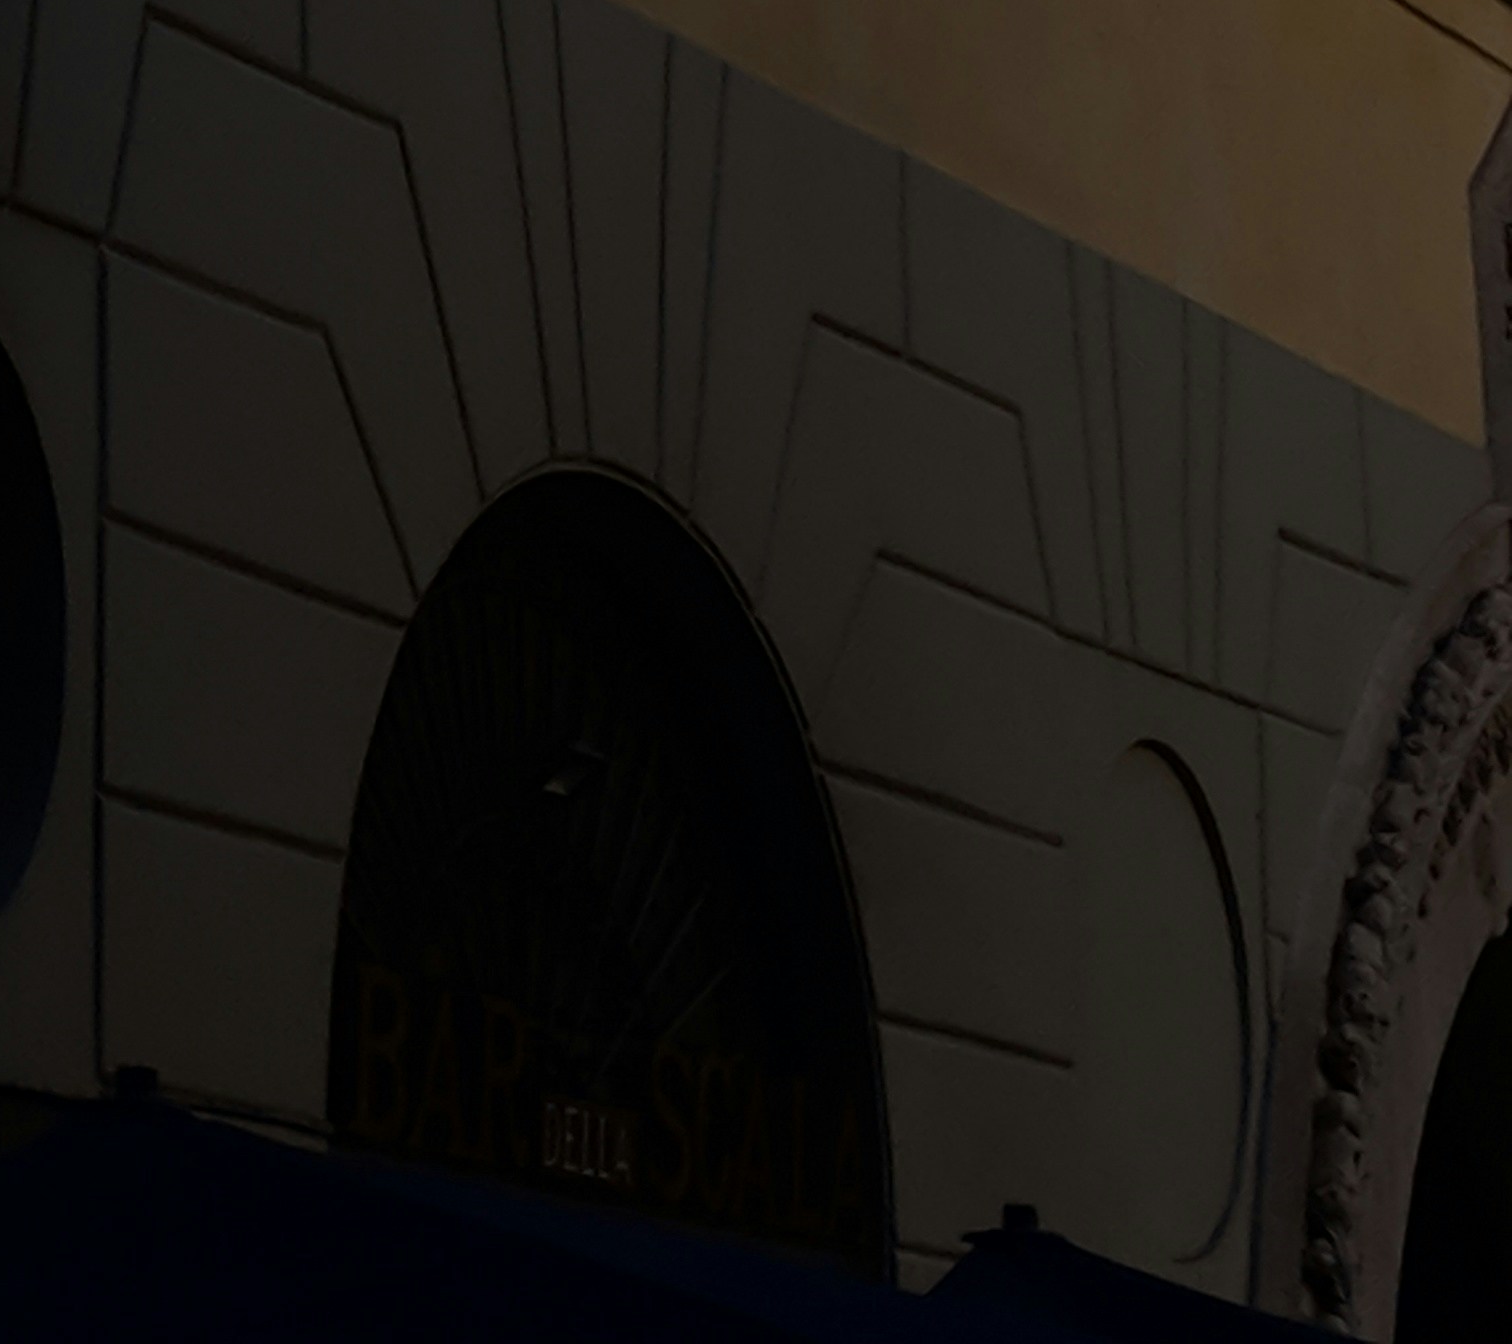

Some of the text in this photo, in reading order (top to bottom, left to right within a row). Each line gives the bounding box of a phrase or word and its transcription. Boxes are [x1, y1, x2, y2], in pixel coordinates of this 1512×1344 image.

[349, 963, 864, 1236] BAR DELLA SCALA
